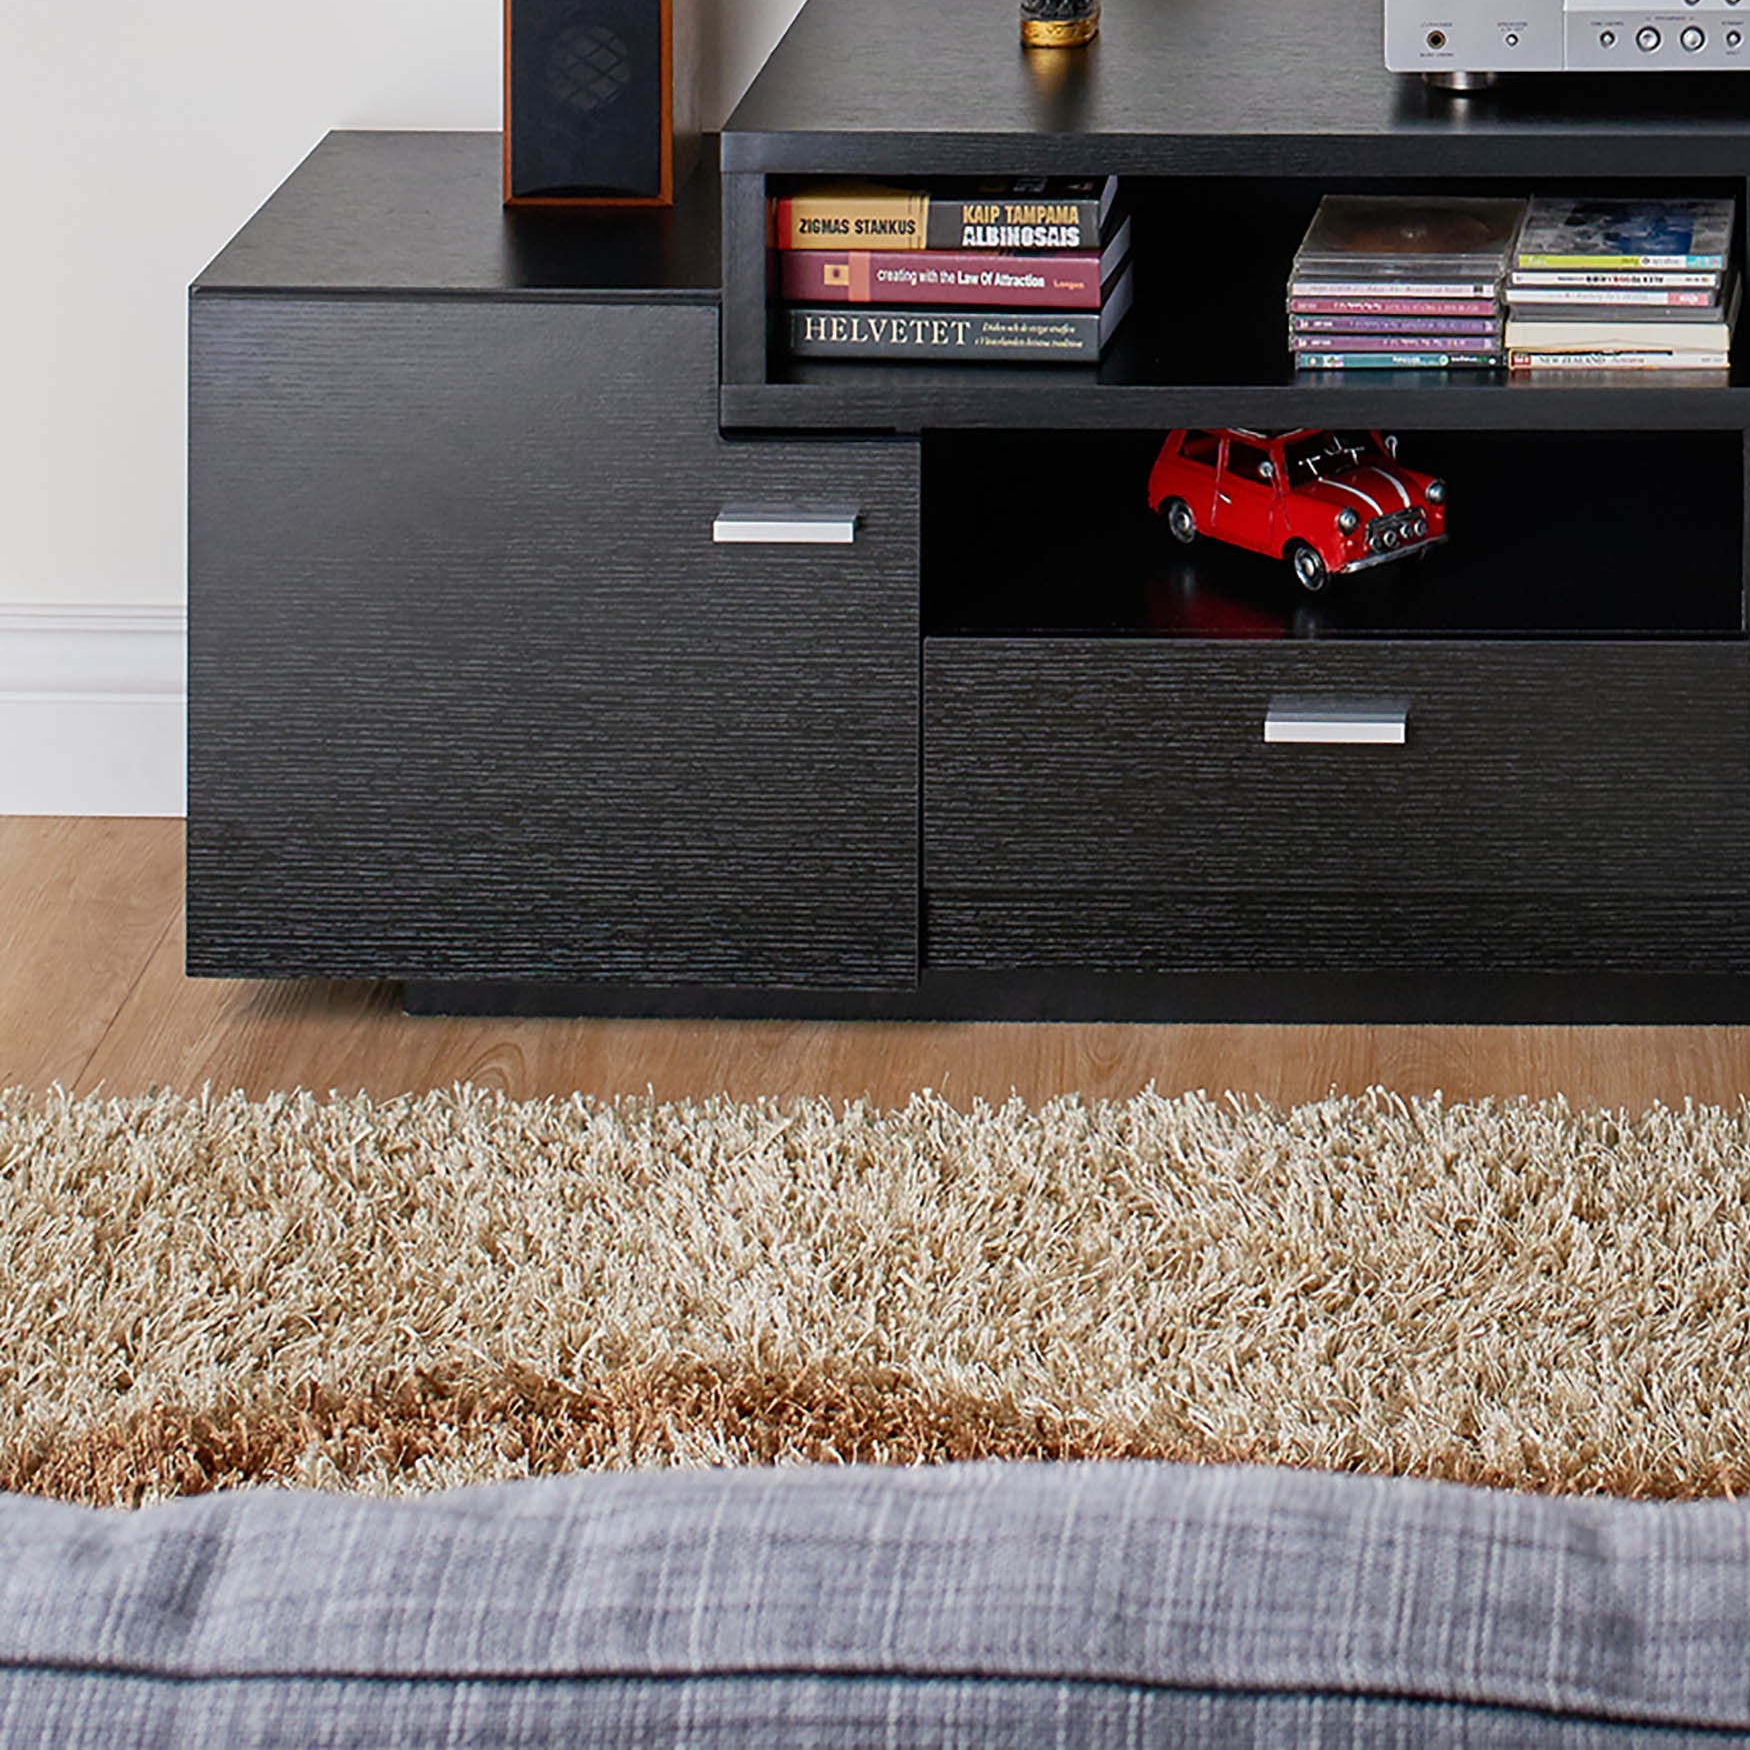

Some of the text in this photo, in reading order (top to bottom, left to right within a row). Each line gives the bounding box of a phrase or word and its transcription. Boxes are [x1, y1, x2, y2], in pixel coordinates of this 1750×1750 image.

[962, 205, 1080, 225] KAIP TAMPAMA
[798, 218, 916, 235] ZIGMAS STANKUS
[962, 226, 1081, 247] ALBINOSAIS
[877, 269, 917, 286] creating
[919, 269, 939, 283] with
[940, 270, 955, 284] the
[957, 270, 979, 285] Law
[980, 271, 993, 286] Of
[994, 272, 1045, 288] Attraction
[804, 315, 971, 346] HELVETET
